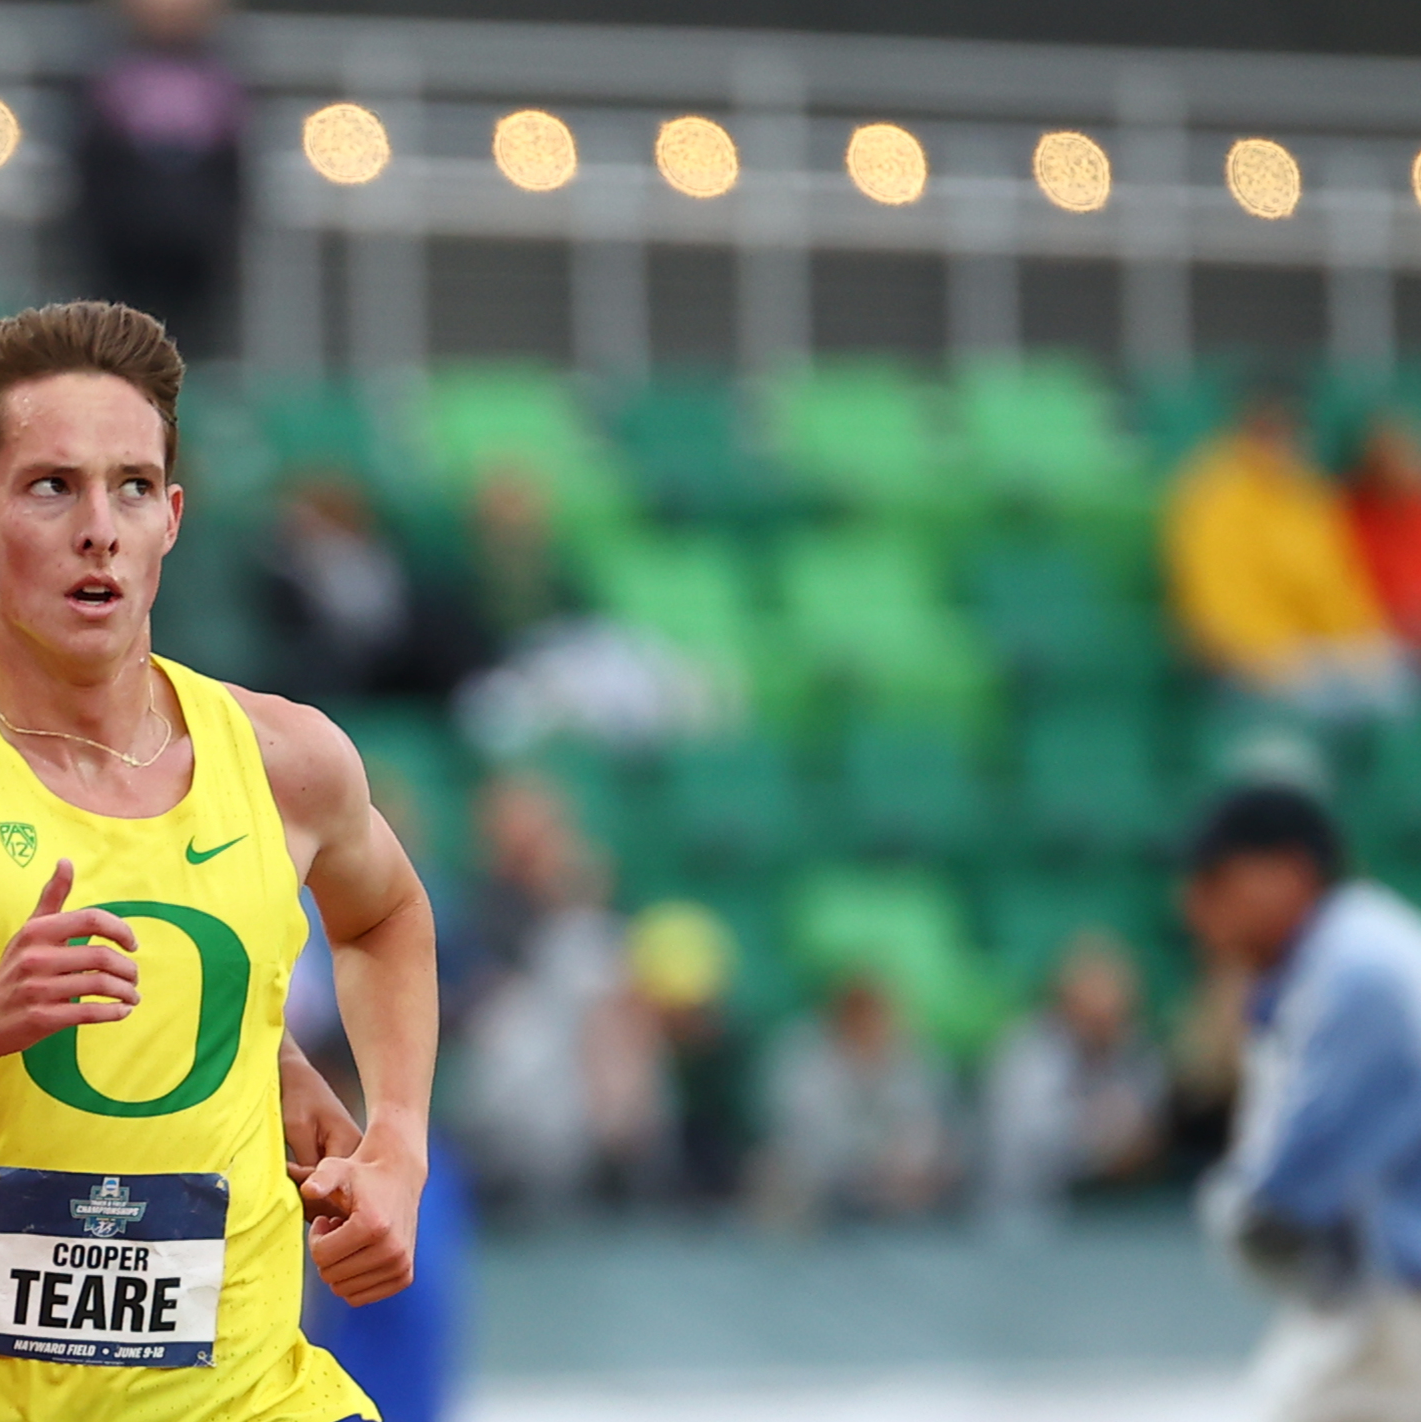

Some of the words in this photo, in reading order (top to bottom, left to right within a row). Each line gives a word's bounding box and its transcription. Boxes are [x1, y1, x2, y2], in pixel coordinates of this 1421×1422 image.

[10, 841, 30, 858] 12
[21, 900, 251, 1118] O
[76, 1204, 140, 1217] CHAMPIONSHIPS
[53, 1242, 150, 1271] COOPER
[10, 1268, 181, 1332] TEARE
[13, 1339, 65, 1355] HAYWARD
[66, 1344, 96, 1356] FIELD
[114, 1345, 142, 1358] JUNE
[142, 1346, 165, 1359] 9-12
